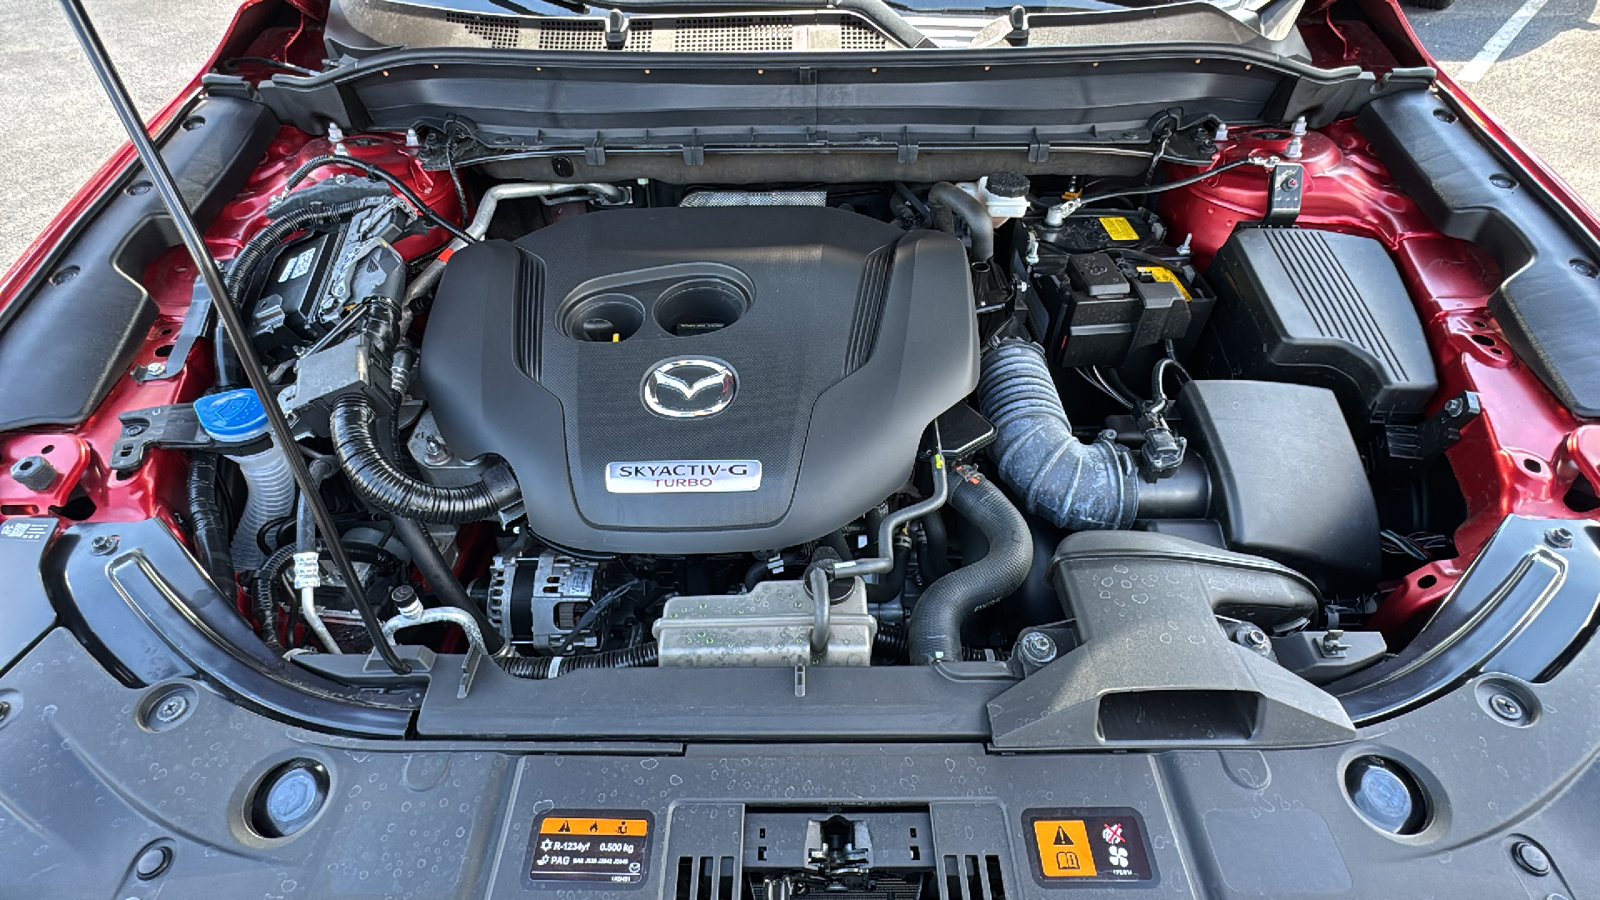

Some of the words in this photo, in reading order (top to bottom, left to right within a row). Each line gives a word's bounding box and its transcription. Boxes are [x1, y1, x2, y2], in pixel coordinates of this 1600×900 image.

[619, 464, 748, 477] SKYACTIV-G
[654, 478, 713, 488] TURBO
[553, 842, 590, 853] R-1234yf
[600, 842, 622, 852] 0.500
[622, 843, 634, 854] kg
[551, 856, 570, 865] PAG
